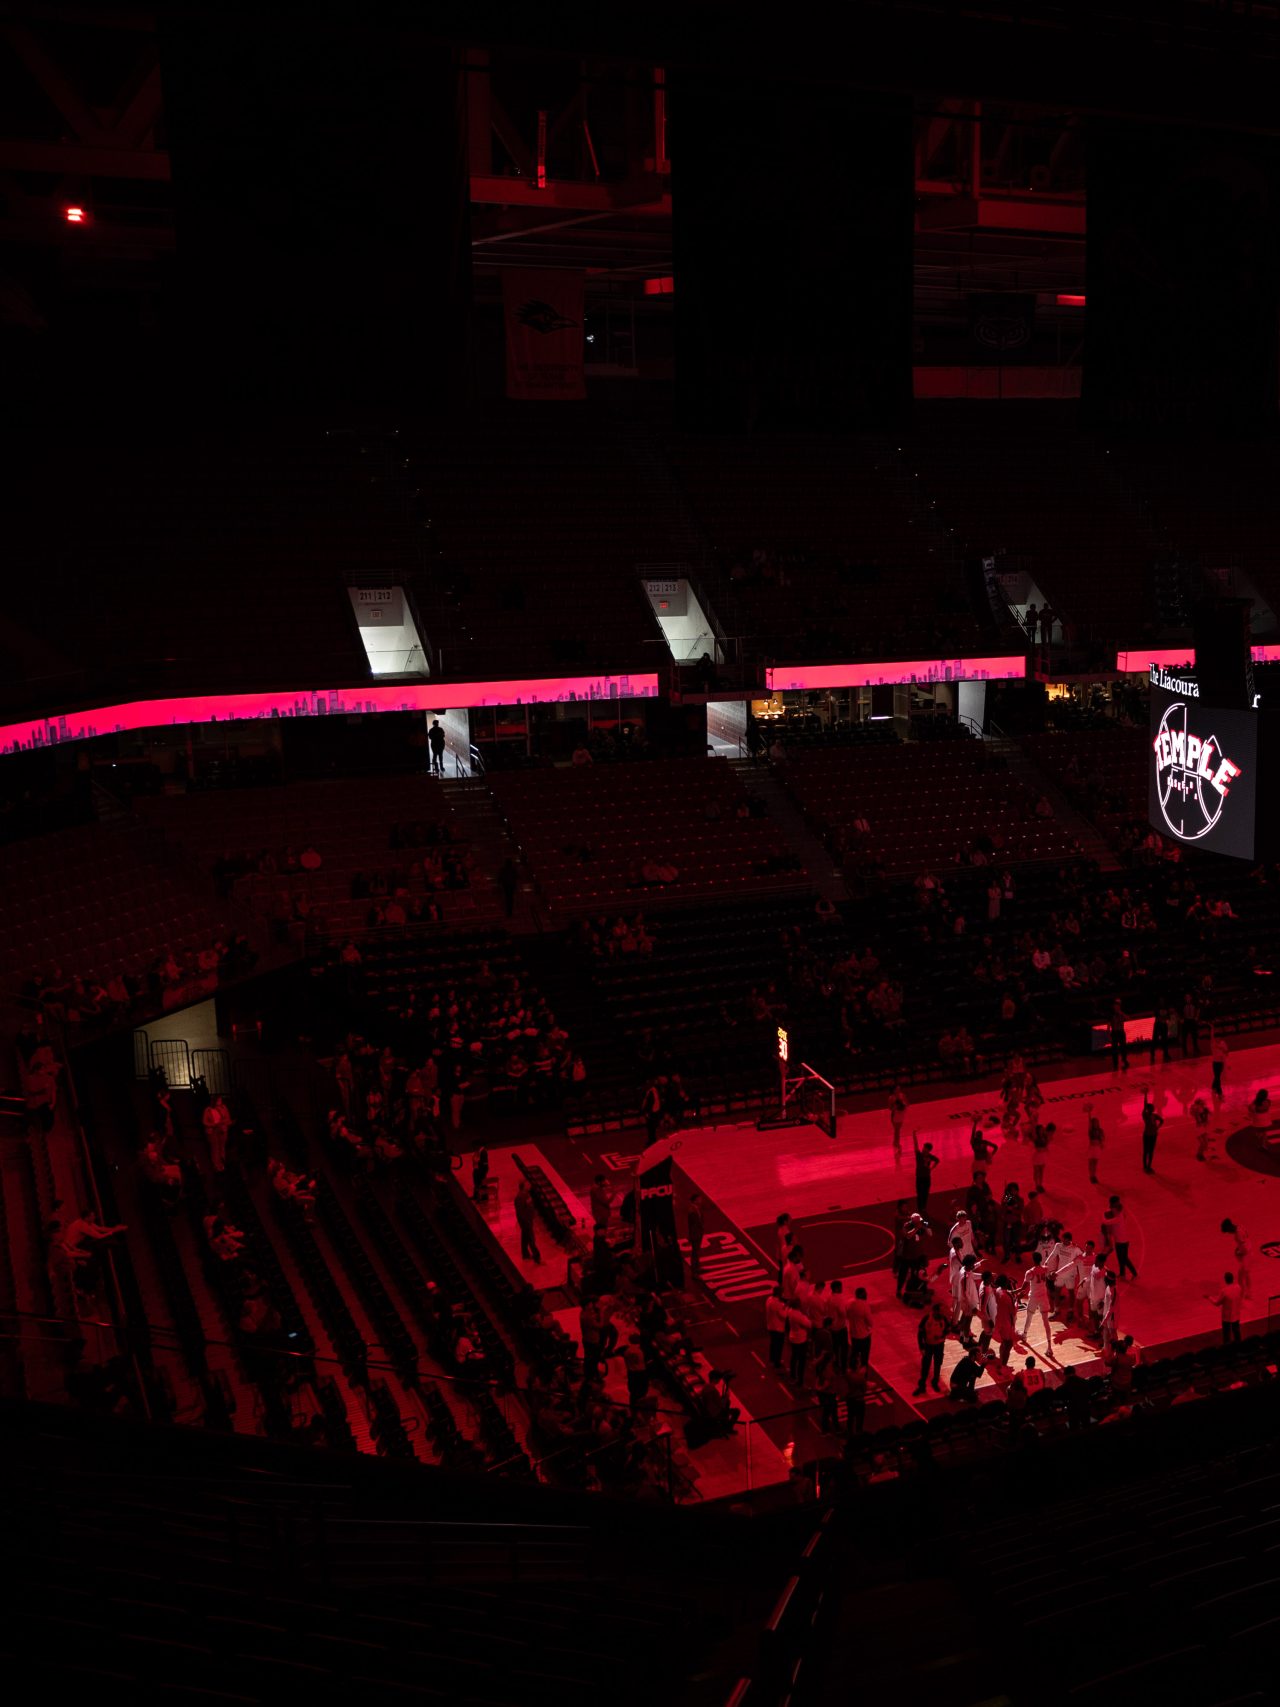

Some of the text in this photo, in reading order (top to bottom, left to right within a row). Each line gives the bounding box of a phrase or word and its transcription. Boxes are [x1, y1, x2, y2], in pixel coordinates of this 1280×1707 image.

[1159, 668, 1200, 698] Liacoura
[1153, 729, 1242, 797] TEMPLE
[641, 1184, 673, 1200] PFCU
